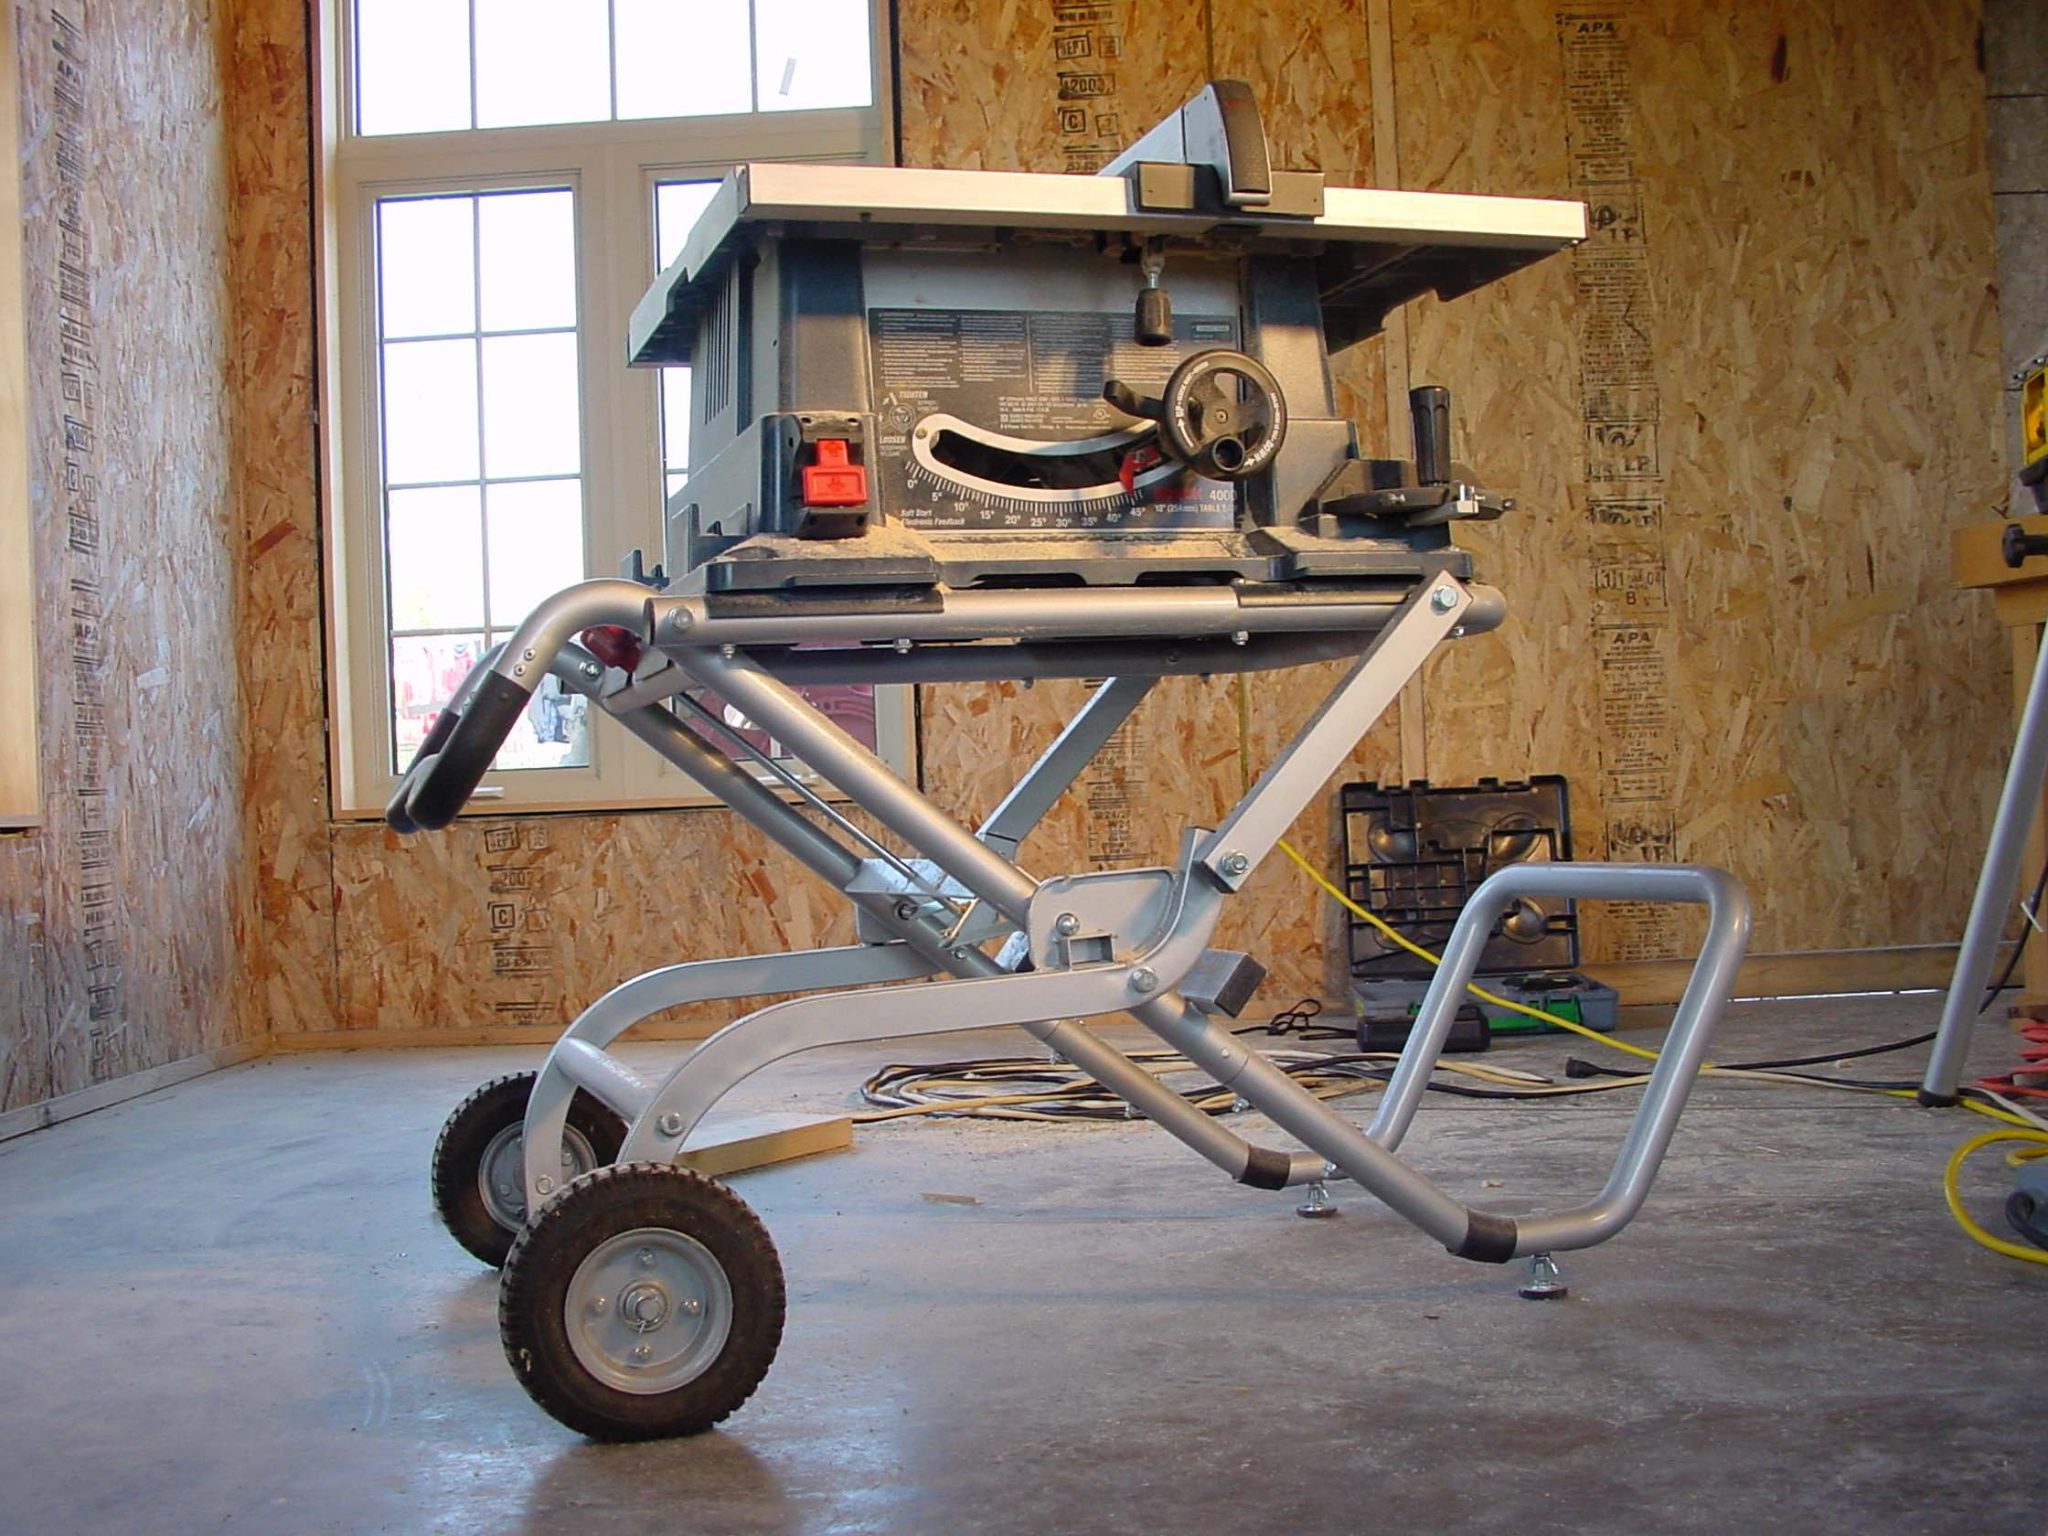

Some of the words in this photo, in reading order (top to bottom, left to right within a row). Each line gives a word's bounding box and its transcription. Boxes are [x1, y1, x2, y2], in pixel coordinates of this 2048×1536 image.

[1577, 22, 1616, 33] APA
[1613, 632, 1651, 644] APA
[498, 908, 508, 925] C
